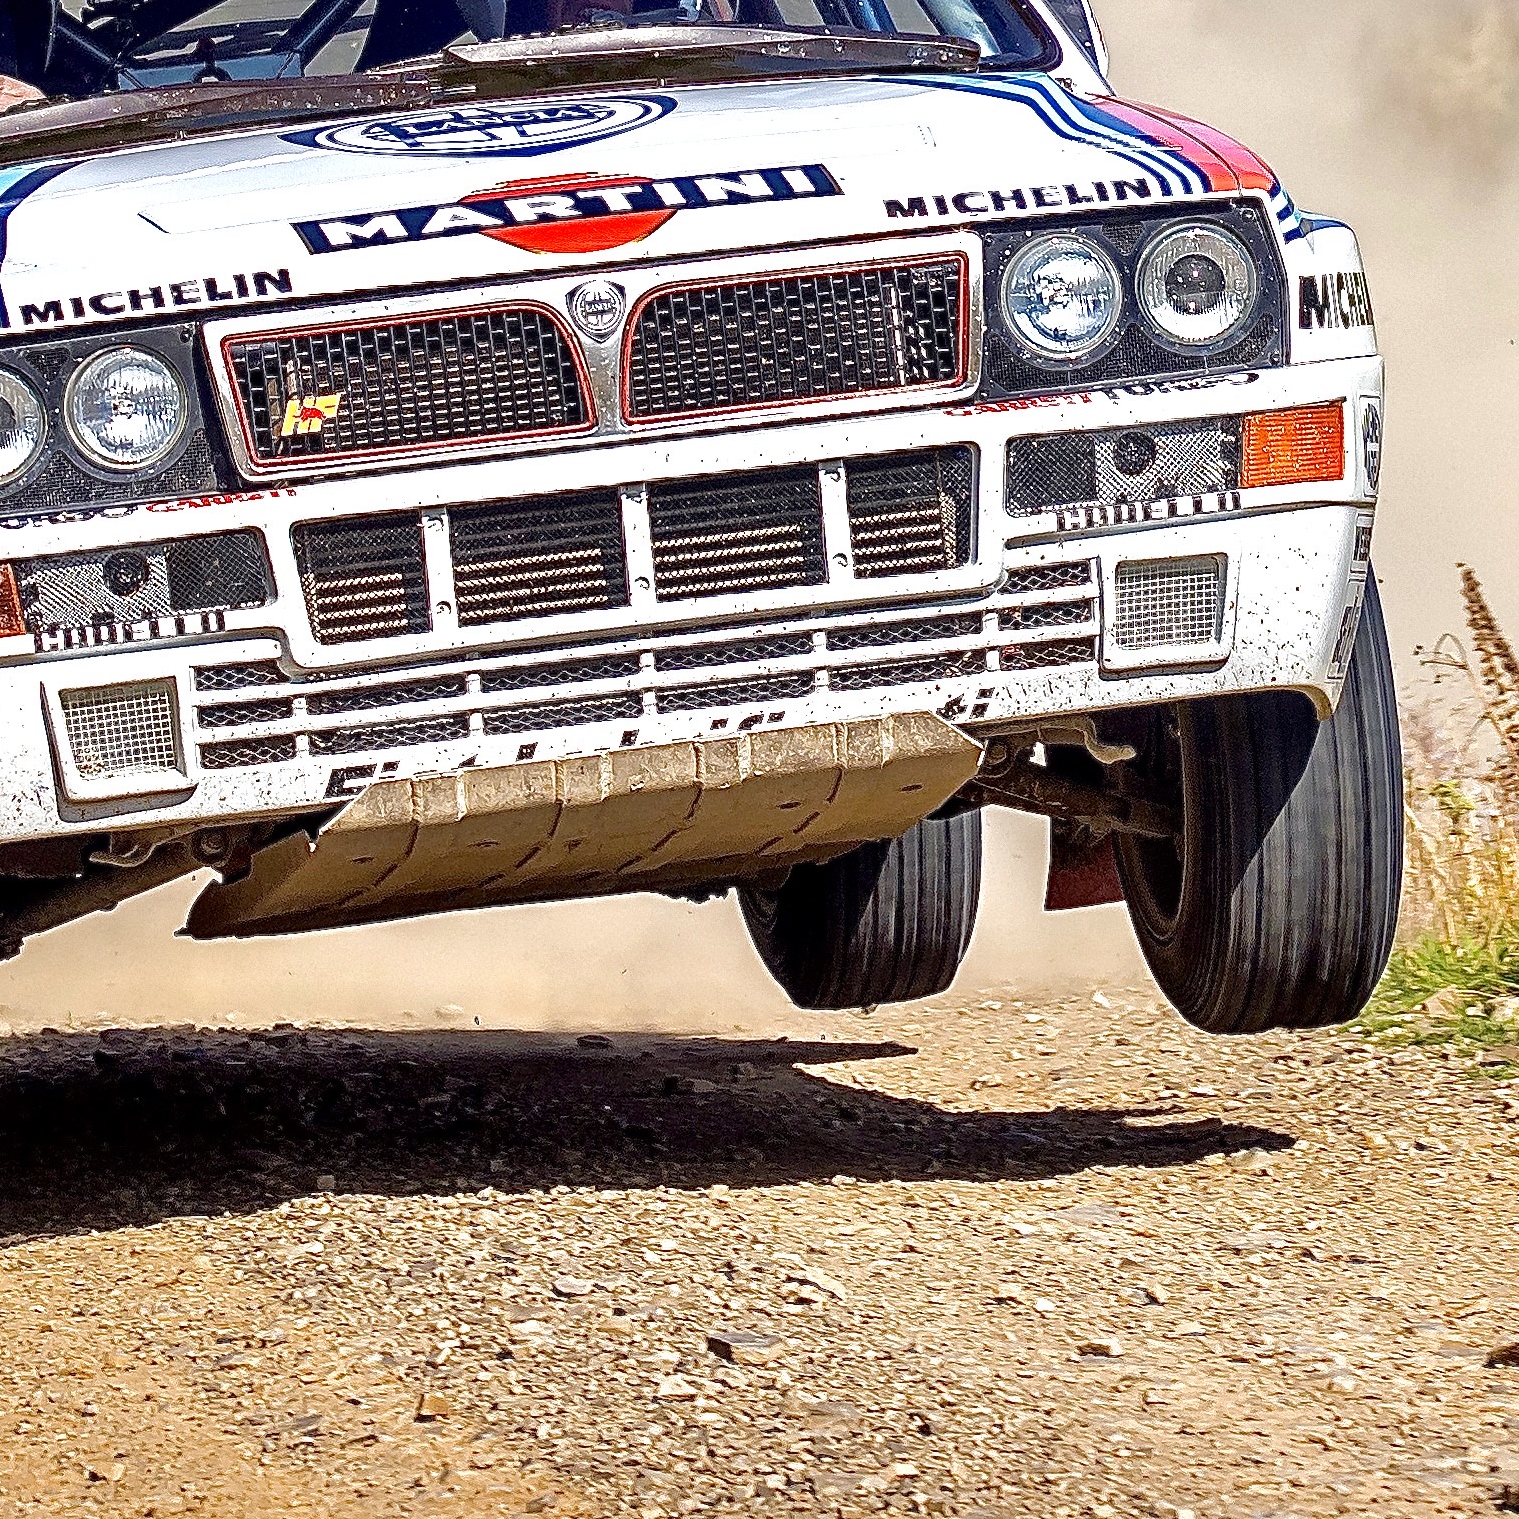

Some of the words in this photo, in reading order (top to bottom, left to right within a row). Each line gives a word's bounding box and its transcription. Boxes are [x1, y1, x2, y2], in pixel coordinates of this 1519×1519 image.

[317, 168, 815, 246] MARTINI
[882, 177, 1152, 219] MICHELIN
[18, 268, 293, 326] MICHELIN
[280, 392, 341, 437] HF
